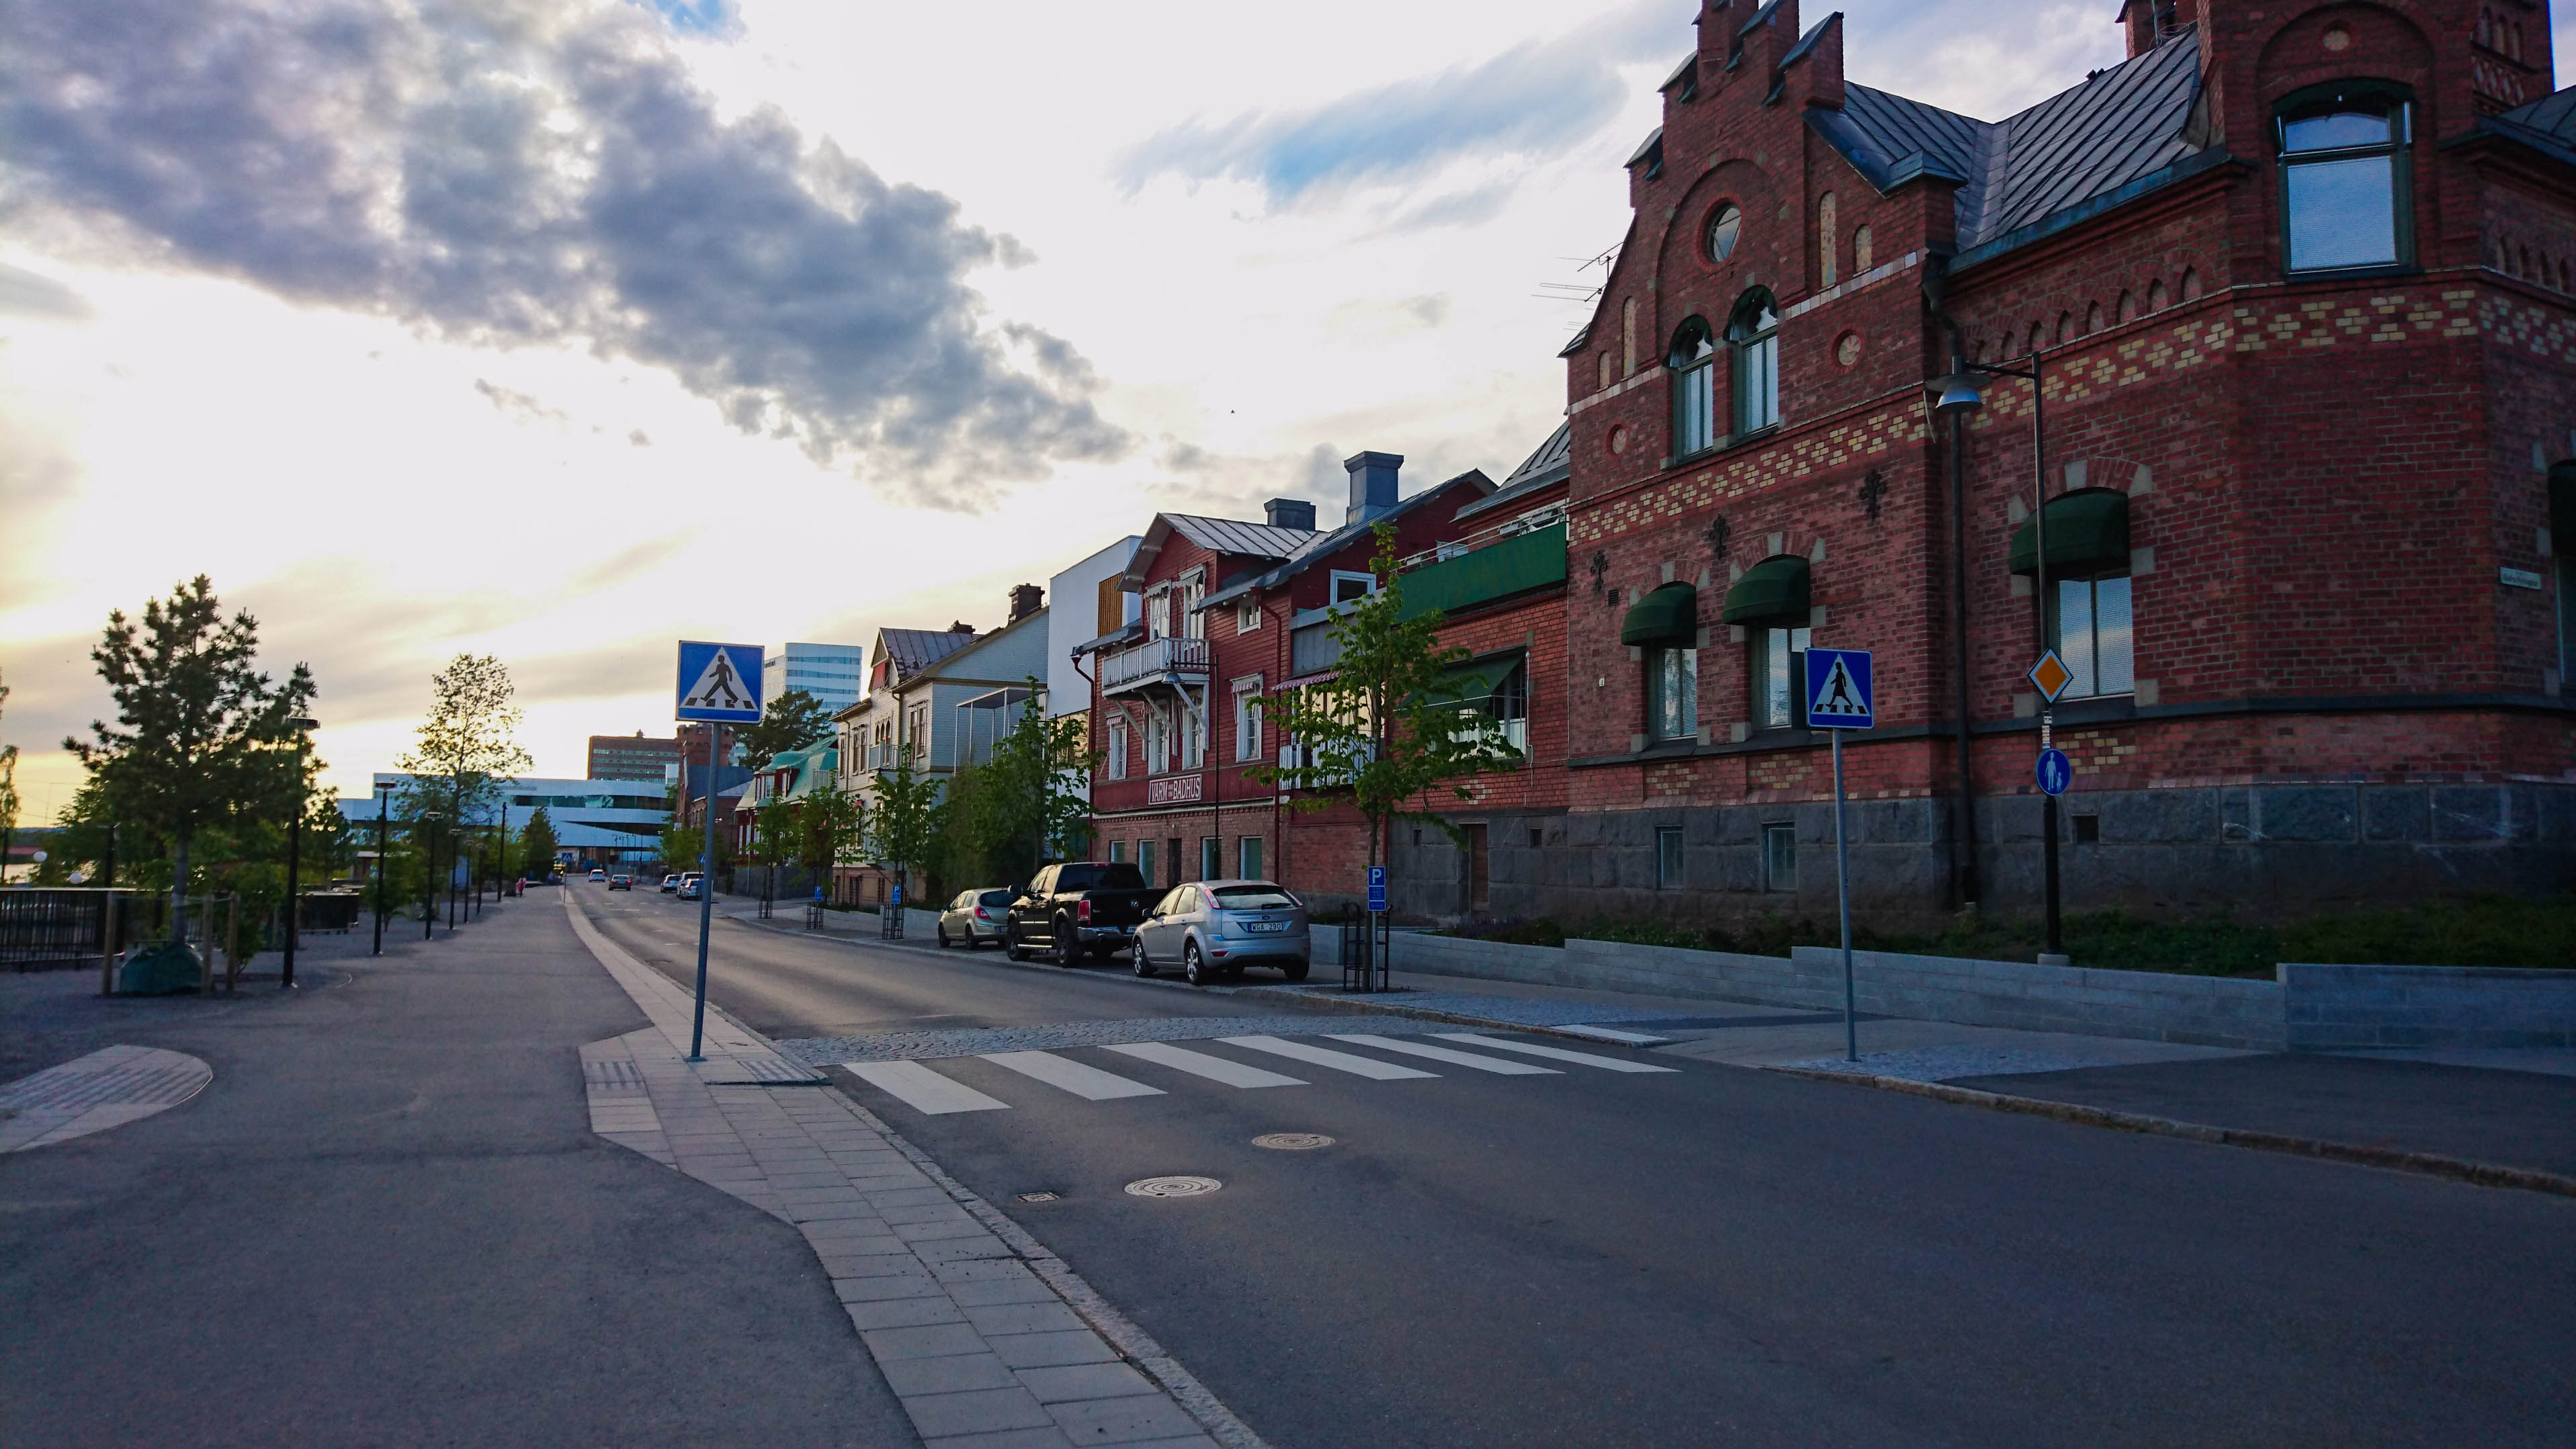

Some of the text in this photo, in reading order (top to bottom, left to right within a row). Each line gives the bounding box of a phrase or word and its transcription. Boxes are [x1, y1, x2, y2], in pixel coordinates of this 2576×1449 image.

[1152, 781, 1168, 801] VARM
[1172, 777, 1200, 800] BADHUS
[1372, 869, 1382, 884] P
